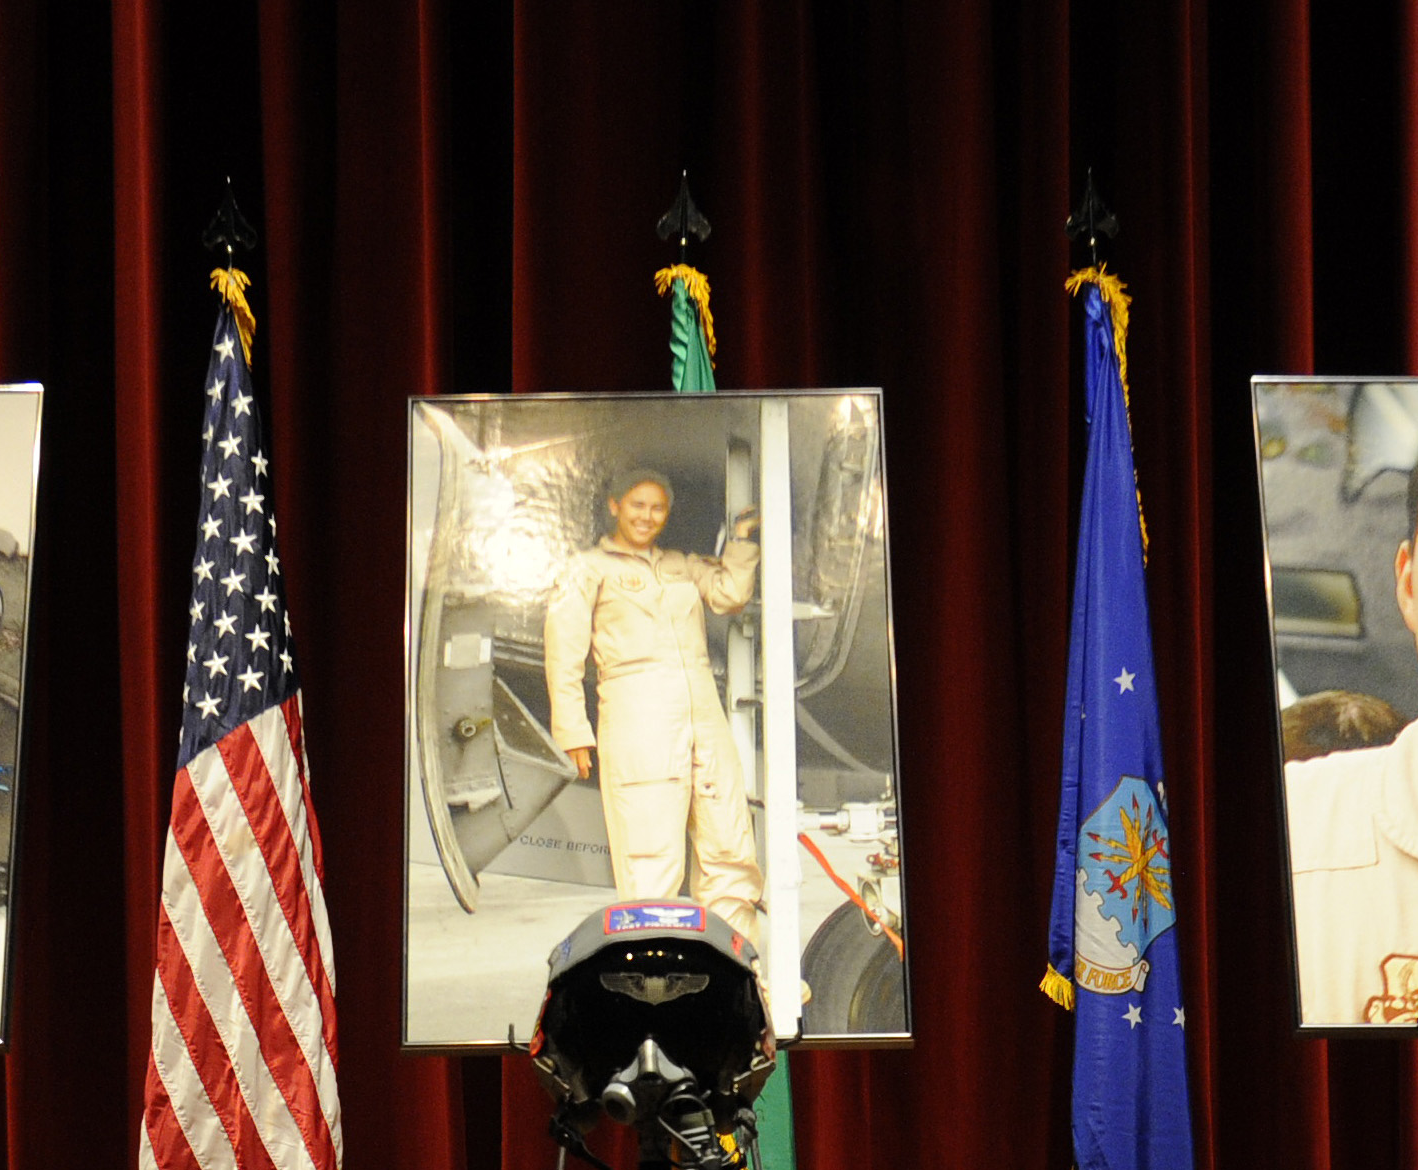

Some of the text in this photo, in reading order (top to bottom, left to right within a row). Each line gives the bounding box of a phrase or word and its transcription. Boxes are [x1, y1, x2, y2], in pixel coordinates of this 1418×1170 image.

[519, 834, 610, 856] CLOSE BEFOR
[1085, 968, 1132, 990] FORCE
